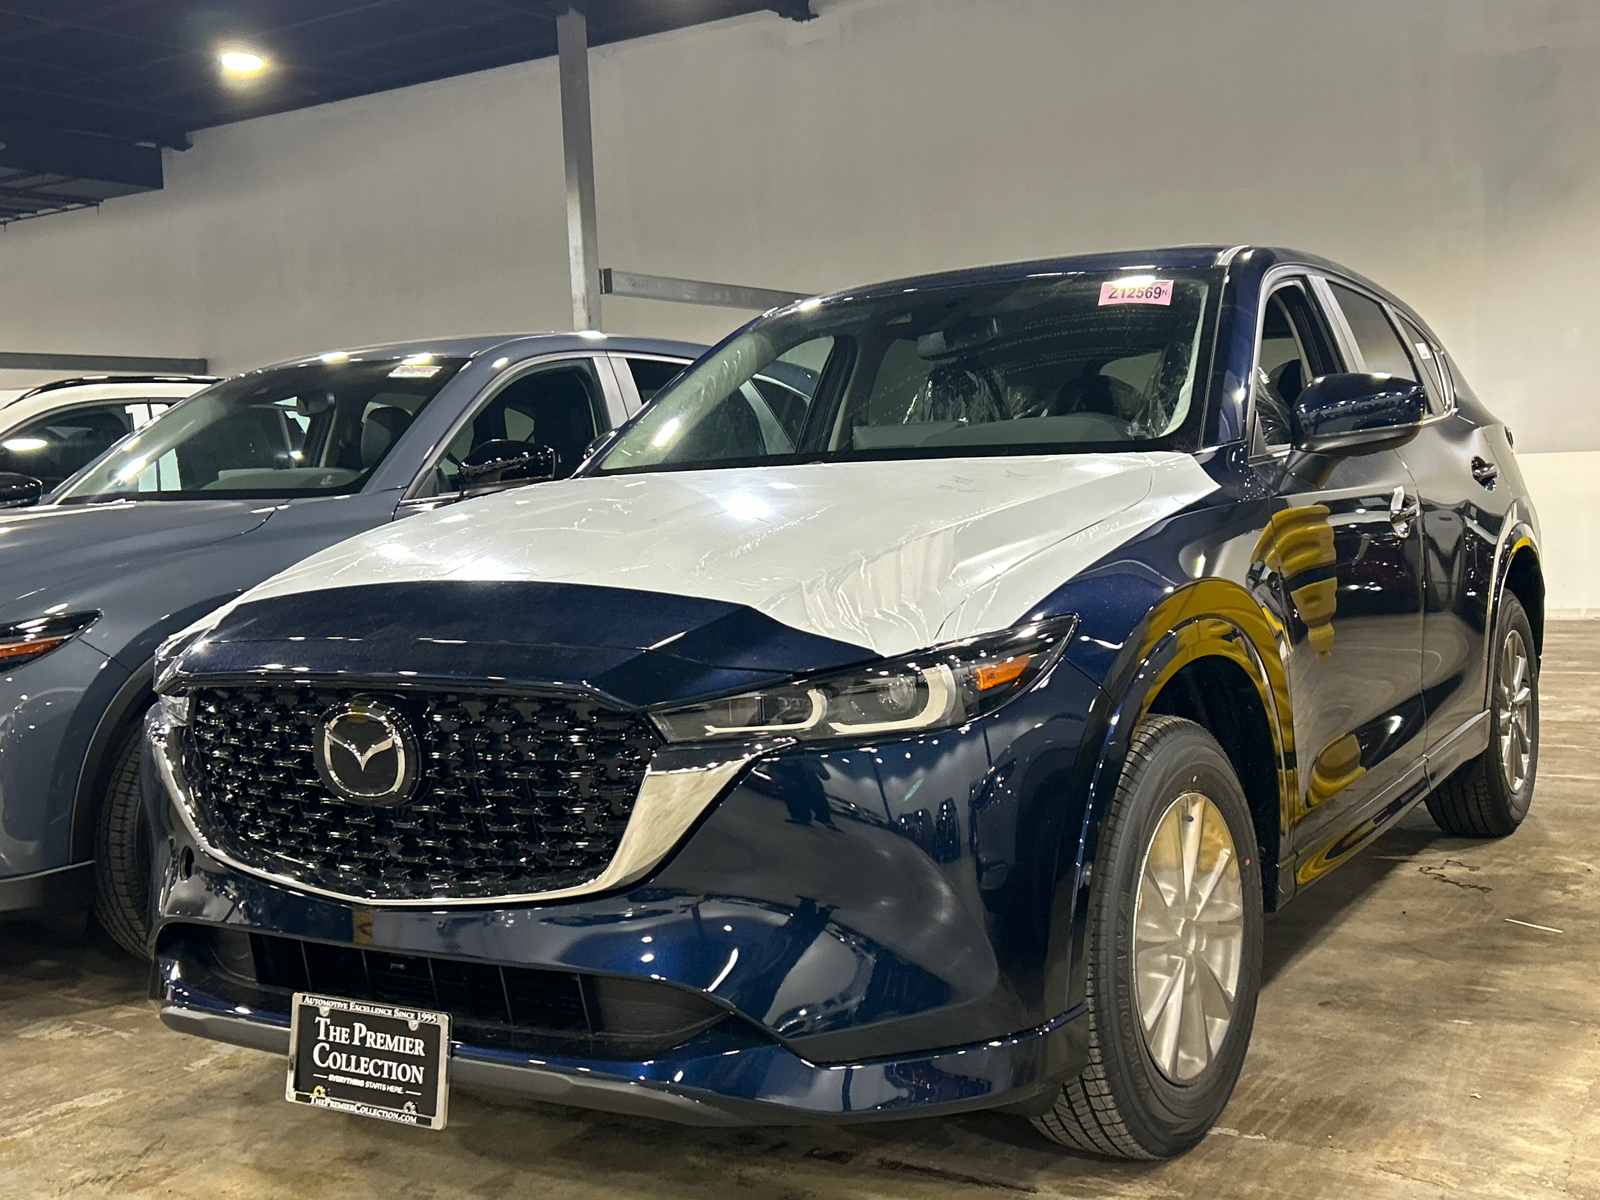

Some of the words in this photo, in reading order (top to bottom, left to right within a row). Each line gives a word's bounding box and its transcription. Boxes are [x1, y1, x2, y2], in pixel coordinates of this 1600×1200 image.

[393, 1008, 416, 1020] SINCE
[416, 1012, 437, 1023] 1995
[314, 1016, 350, 1045] THE
[352, 1022, 425, 1057] PREMIER
[312, 1042, 425, 1085] COLLECTION
[328, 1073, 365, 1087] EVERYTHING
[365, 1080, 387, 1092] STARTS
